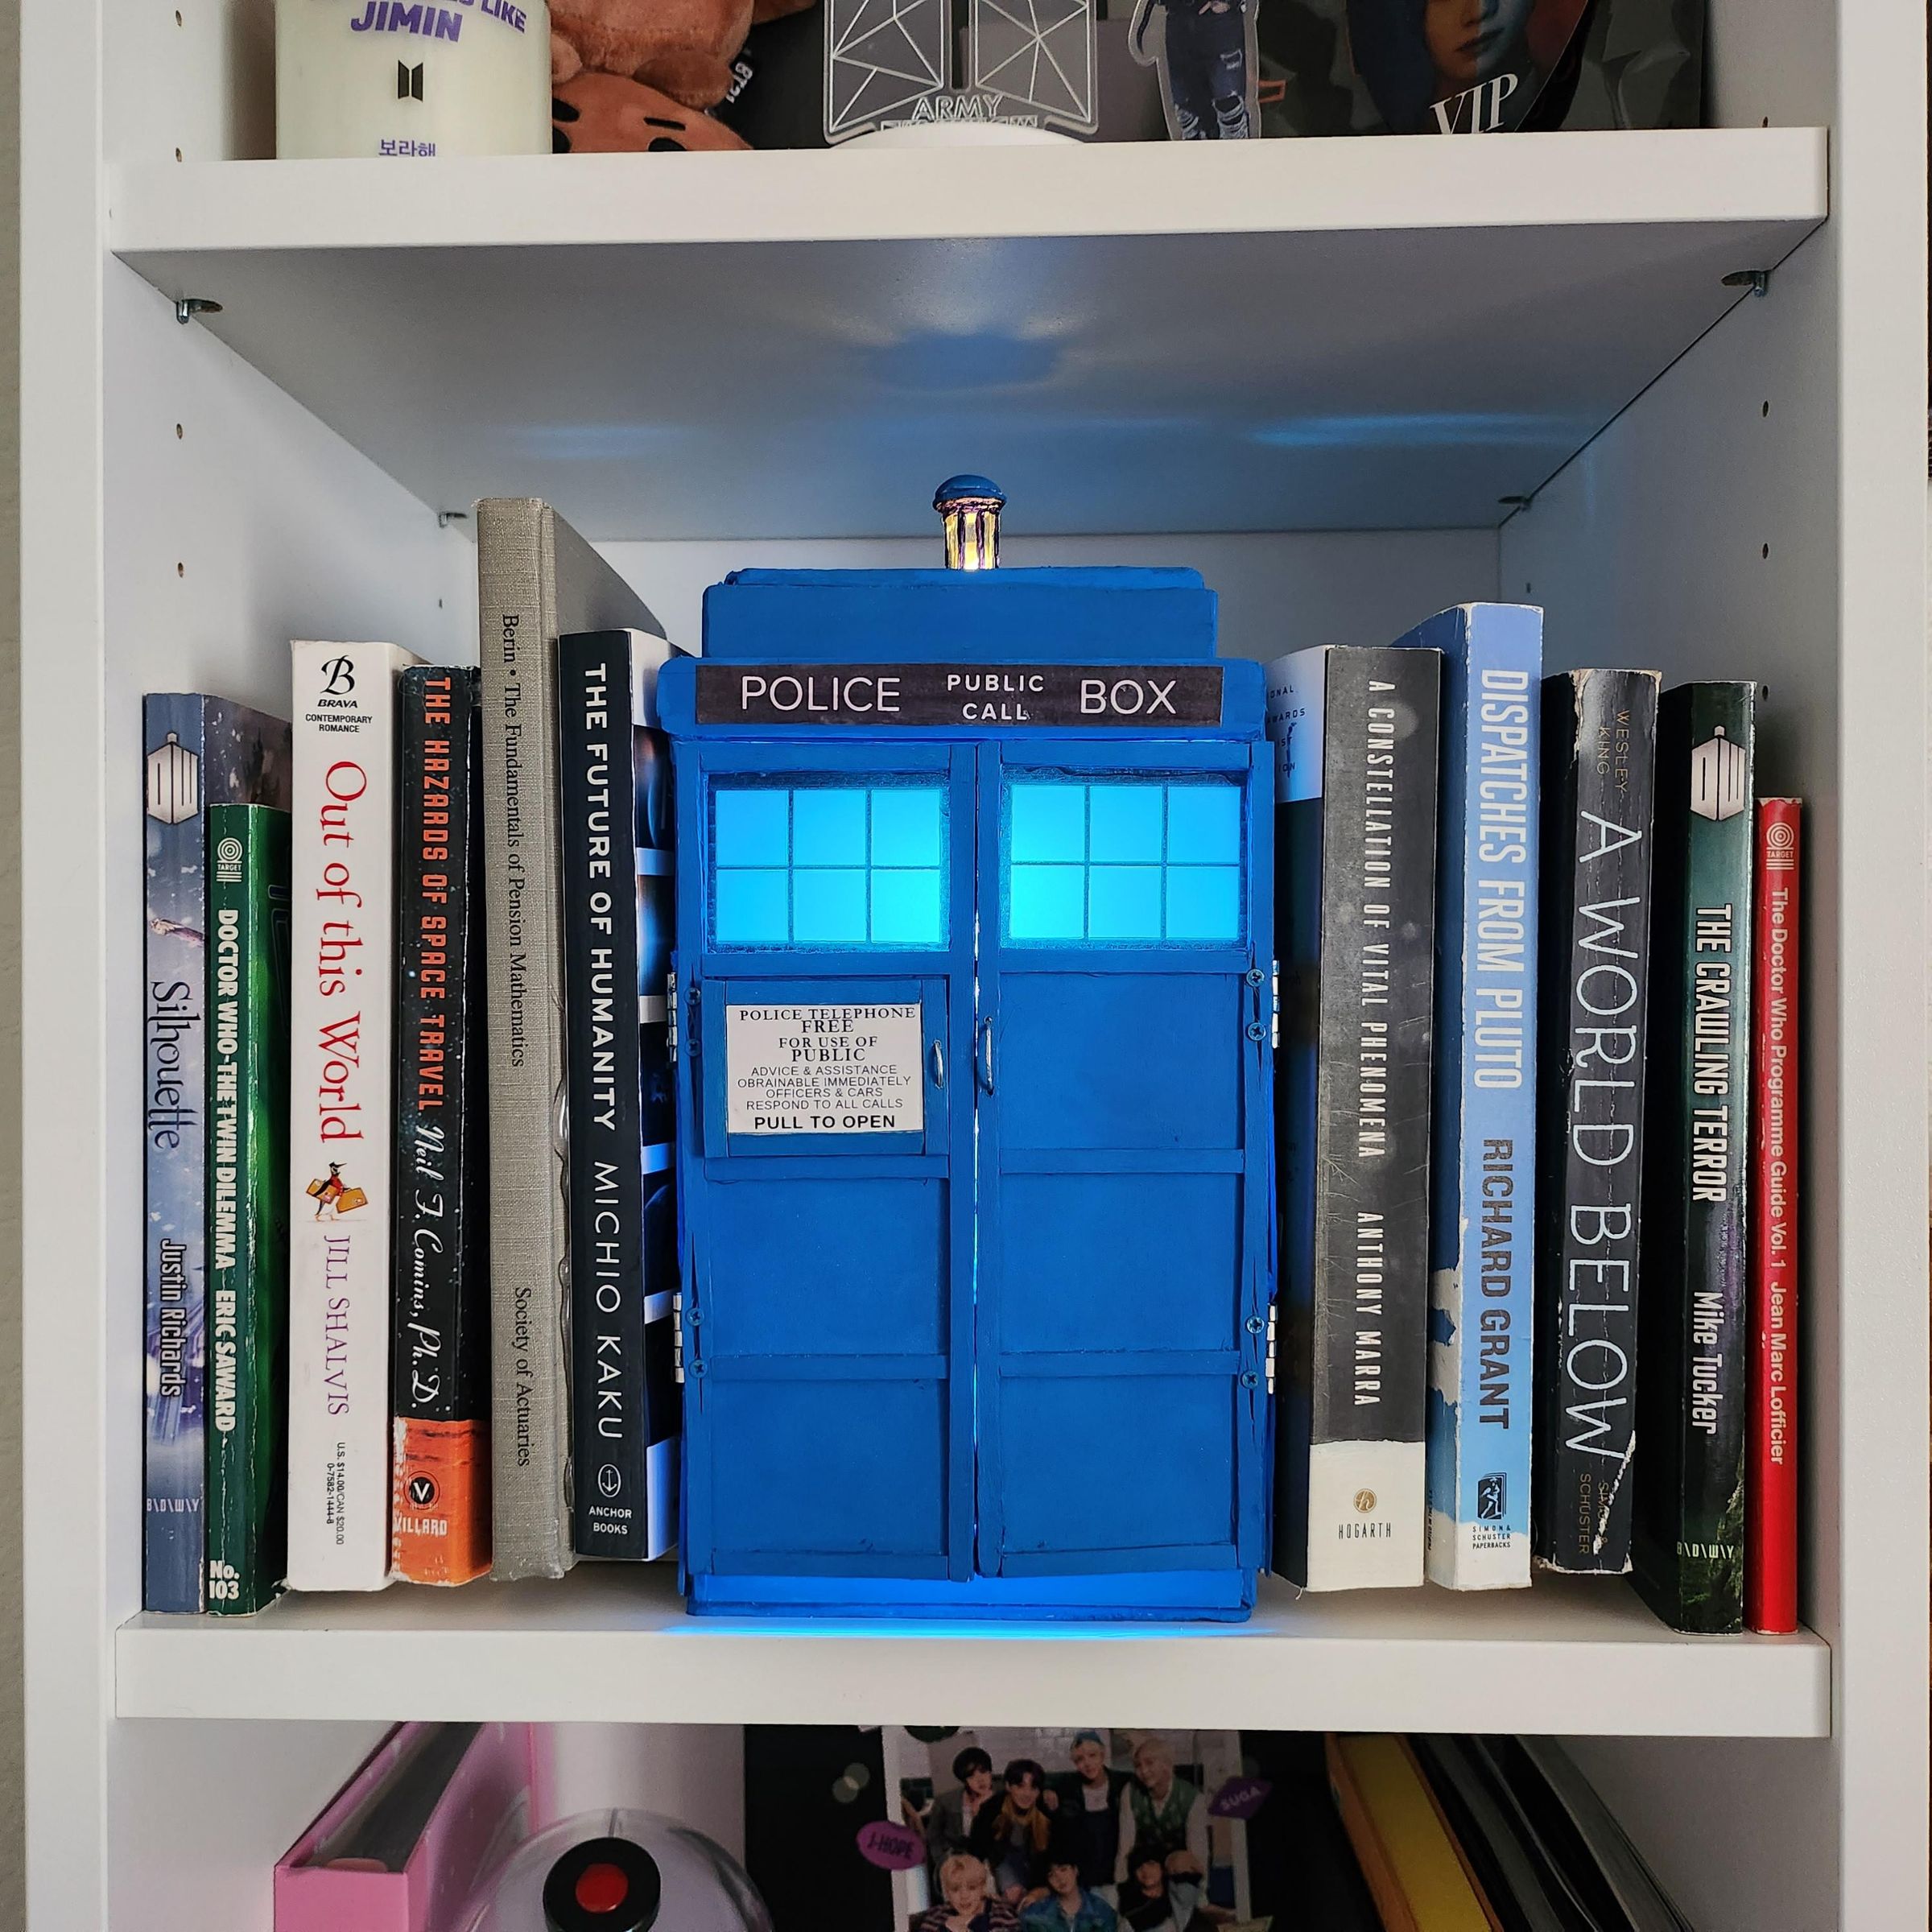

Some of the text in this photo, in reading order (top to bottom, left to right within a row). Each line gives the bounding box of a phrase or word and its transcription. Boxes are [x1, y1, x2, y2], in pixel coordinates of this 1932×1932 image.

[351, 2, 463, 42] JIMIN
[481, 0, 527, 33] LIKE
[911, 94, 1004, 121] ARMY
[1429, 73, 1518, 134] VIP
[378, 139, 436, 156] 보라해
[320, 654, 355, 695] B
[741, 674, 1177, 720] POLICE PUBLIC CALL BOX
[305, 714, 373, 724] CONTEMPORARY
[317, 699, 357, 708] BRAVA
[319, 724, 360, 733] ROMANCE
[1596, 726, 1611, 774] KING
[1615, 710, 1630, 792] WESLEY
[502, 613, 528, 1067] Berin The Fundamentals of Pension Mathematics
[419, 677, 450, 1111] THE HAZARDS OF SPACE TRAVEL
[585, 663, 616, 1130] THE FUTURE OF HUMANITY
[1473, 669, 1530, 1088] DISPATCHES FROM PLUTO
[1358, 680, 1395, 1158] A CONSTELLATION OF VITAL PHENOMENA
[218, 910, 239, 996] DOCTOR
[316, 761, 367, 1143] Out of this World
[740, 1008, 916, 1021] POLICE TELEPHONE
[779, 1036, 877, 1048] FOR USE OF
[801, 1020, 854, 1033] FREE
[148, 982, 200, 1148] Silhouette
[751, 1064, 897, 1076] ADVICE & ASSISTANCE
[791, 1048, 865, 1062] PUBLIC
[1693, 904, 1732, 1202] THE CRAWLING TERROR
[1767, 887, 1789, 1267] The Doctor Who Programme Guide Vol. 1
[737, 1076, 911, 1088] OBRAINABLE IMMEDIATELY
[746, 1099, 902, 1110] RESPOND TO ALL CALLS
[766, 1088, 882, 1098] OFFICERS & CARS
[217, 1104, 237, 1162] TWIN
[754, 1115, 895, 1129] PULL TO OPEN
[1566, 811, 1642, 1459] A WORLD BELOW
[415, 1125, 444, 1180] Neil
[216, 1167, 237, 1269] DILEMMA
[410, 1228, 443, 1317] Comins,
[594, 1161, 623, 1438] MICHIO KAKU
[1479, 1139, 1513, 1430] RICHARD GRANT
[161, 1240, 188, 1397] Justin Richards
[216, 1290, 237, 1336] ERIC
[324, 1234, 350, 1415] JILL SHALVIS
[1353, 1212, 1384, 1406] ANTHONY MARRA
[215, 1341, 236, 1431] SAWARD
[510, 1287, 534, 1466] Society of Actuaries
[1691, 1292, 1725, 1435] Mike Tucker
[1770, 1282, 1787, 1464] Jean Marc Lofficier
[327, 1463, 335, 1524] 0-7582-1444-8
[336, 1442, 345, 1545] U.S. $14.00/CAN $20.00
[589, 1505, 633, 1519] ANCHOR
[1579, 1473, 1591, 1554] SCHUSTER
[1598, 1482, 1609, 1532] SIMO
[394, 1512, 447, 1537] VILLARD
[592, 1522, 629, 1534] BOOKS
[1338, 1522, 1393, 1539] HOGARTH
[209, 1580, 239, 1600] 103
[210, 1560, 240, 1579] No.
[1220, 1786, 1261, 1811] SUGA
